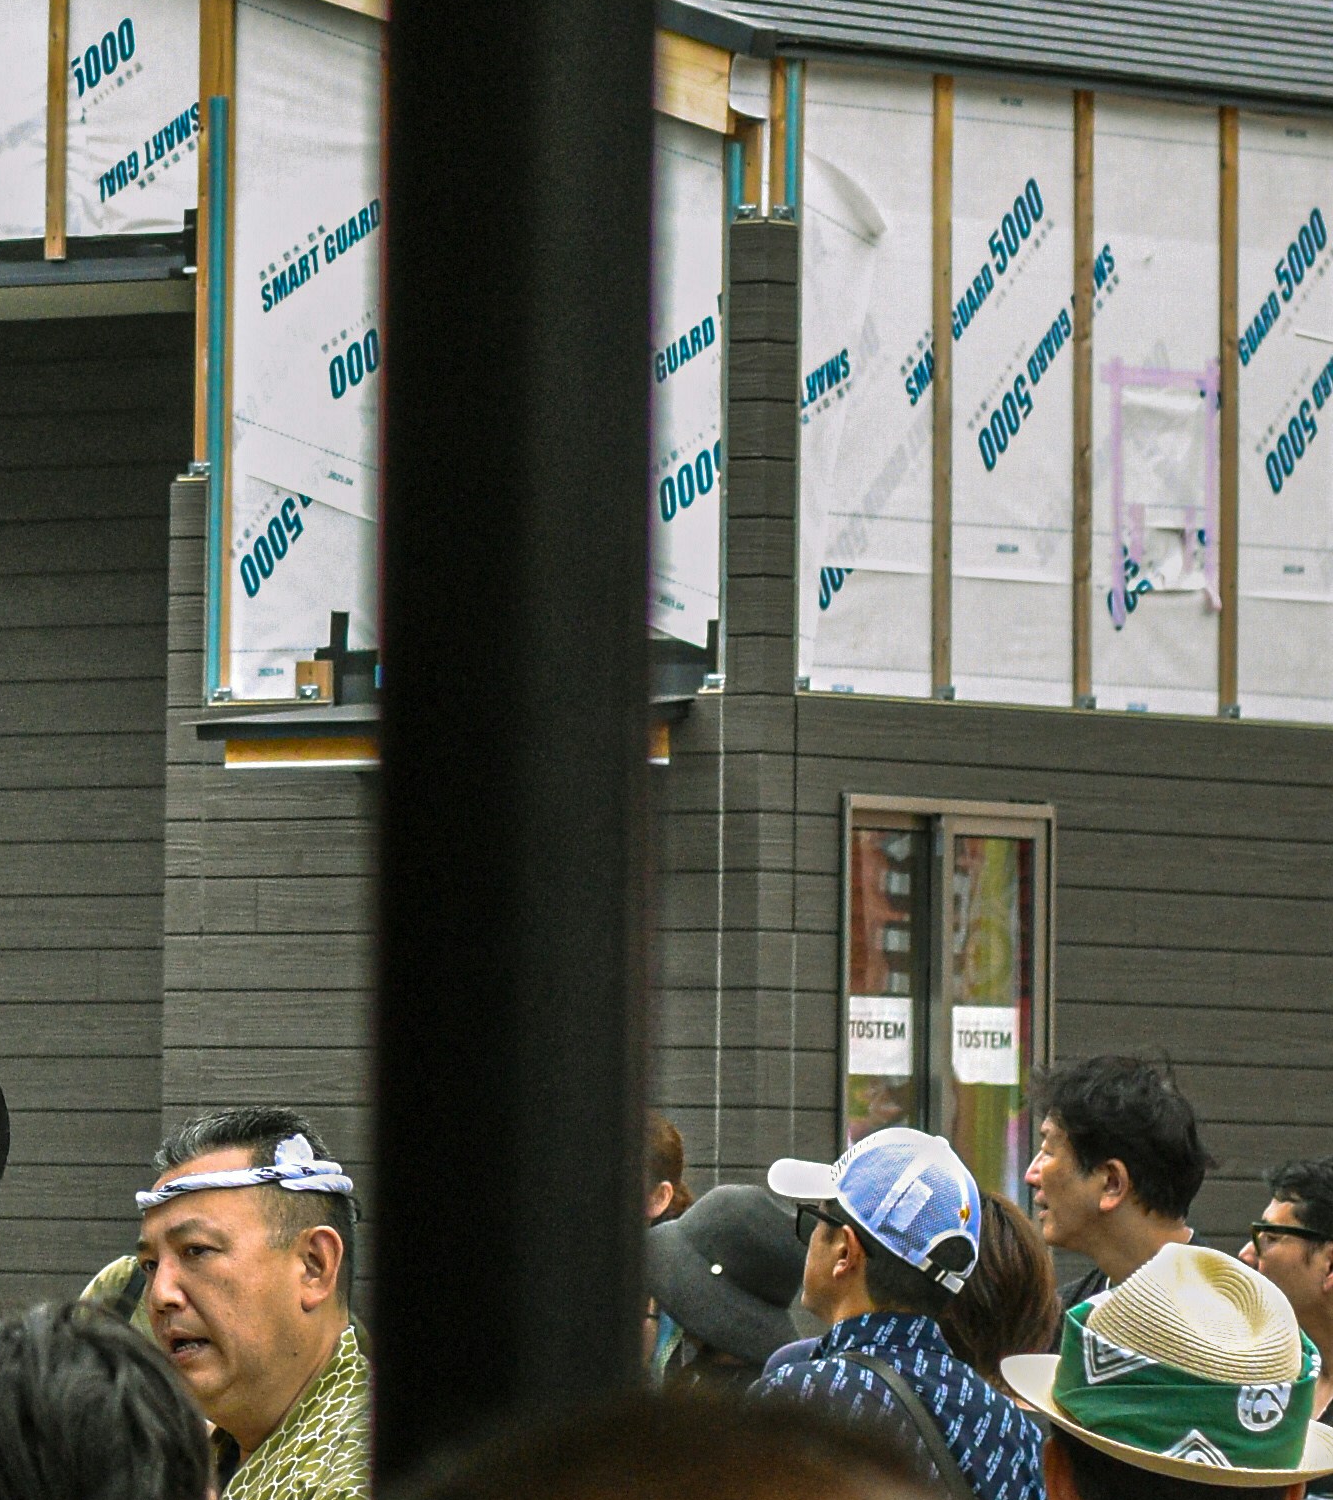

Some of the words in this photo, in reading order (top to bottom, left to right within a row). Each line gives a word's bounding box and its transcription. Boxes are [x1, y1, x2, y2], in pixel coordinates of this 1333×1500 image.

[98, 148, 141, 203] GUA
[142, 101, 200, 172] SMART
[260, 244, 321, 314] SMART
[323, 198, 382, 266] GUARD
[952, 262, 995, 342] GUARD
[988, 177, 1045, 275] 5000
[1238, 291, 1281, 367] GUARD
[1274, 206, 1328, 302] 5000
[654, 315, 716, 384] GUARD
[1026, 307, 1072, 387] GUARD
[977, 372, 1034, 472] 5000
[1265, 397, 1319, 494] 5000
[239, 496, 304, 599] 5000
[849, 1020, 906, 1039] TOSTEM
[957, 1029, 1012, 1049] TOSTEM
